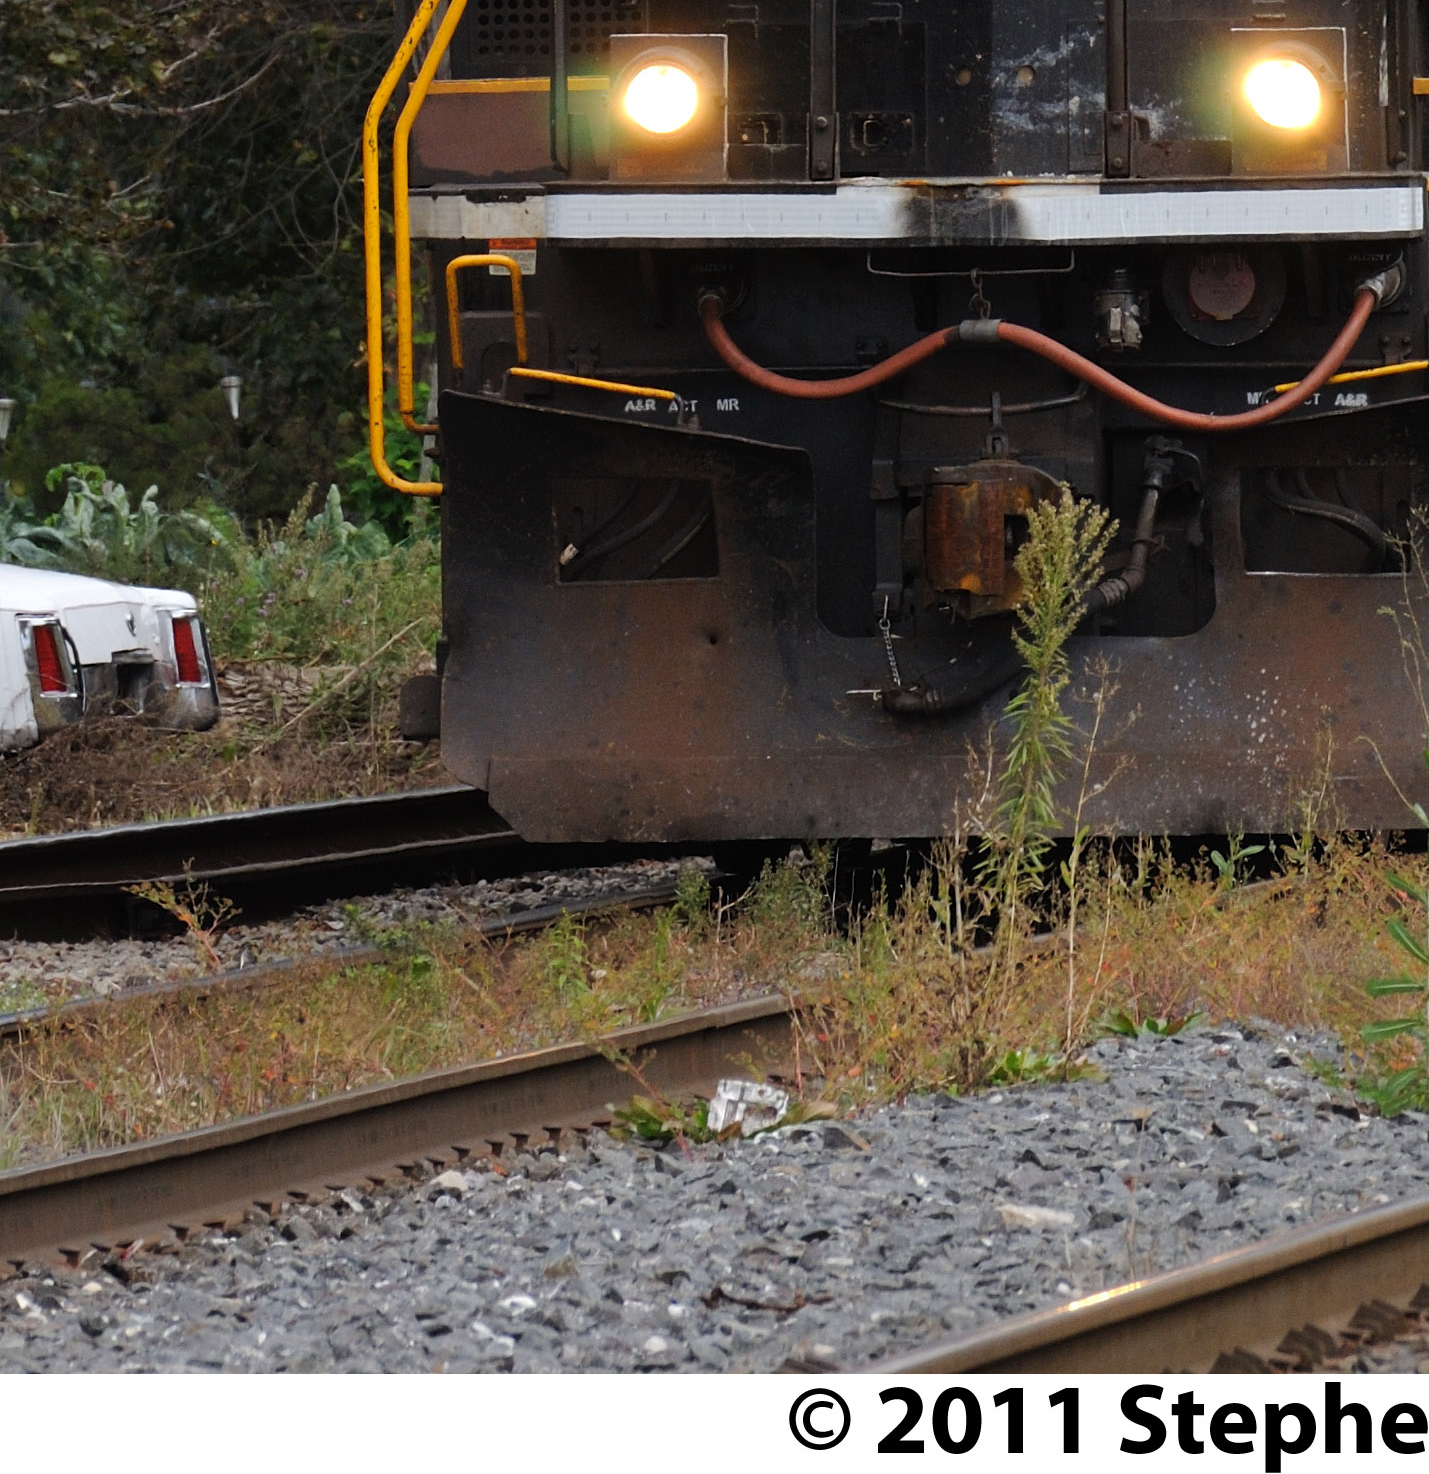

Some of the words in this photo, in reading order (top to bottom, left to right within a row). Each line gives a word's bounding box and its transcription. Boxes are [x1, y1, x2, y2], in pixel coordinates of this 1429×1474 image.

[624, 399, 656, 413] A&R
[716, 398, 740, 411] MR
[1334, 393, 1368, 407] A&R
